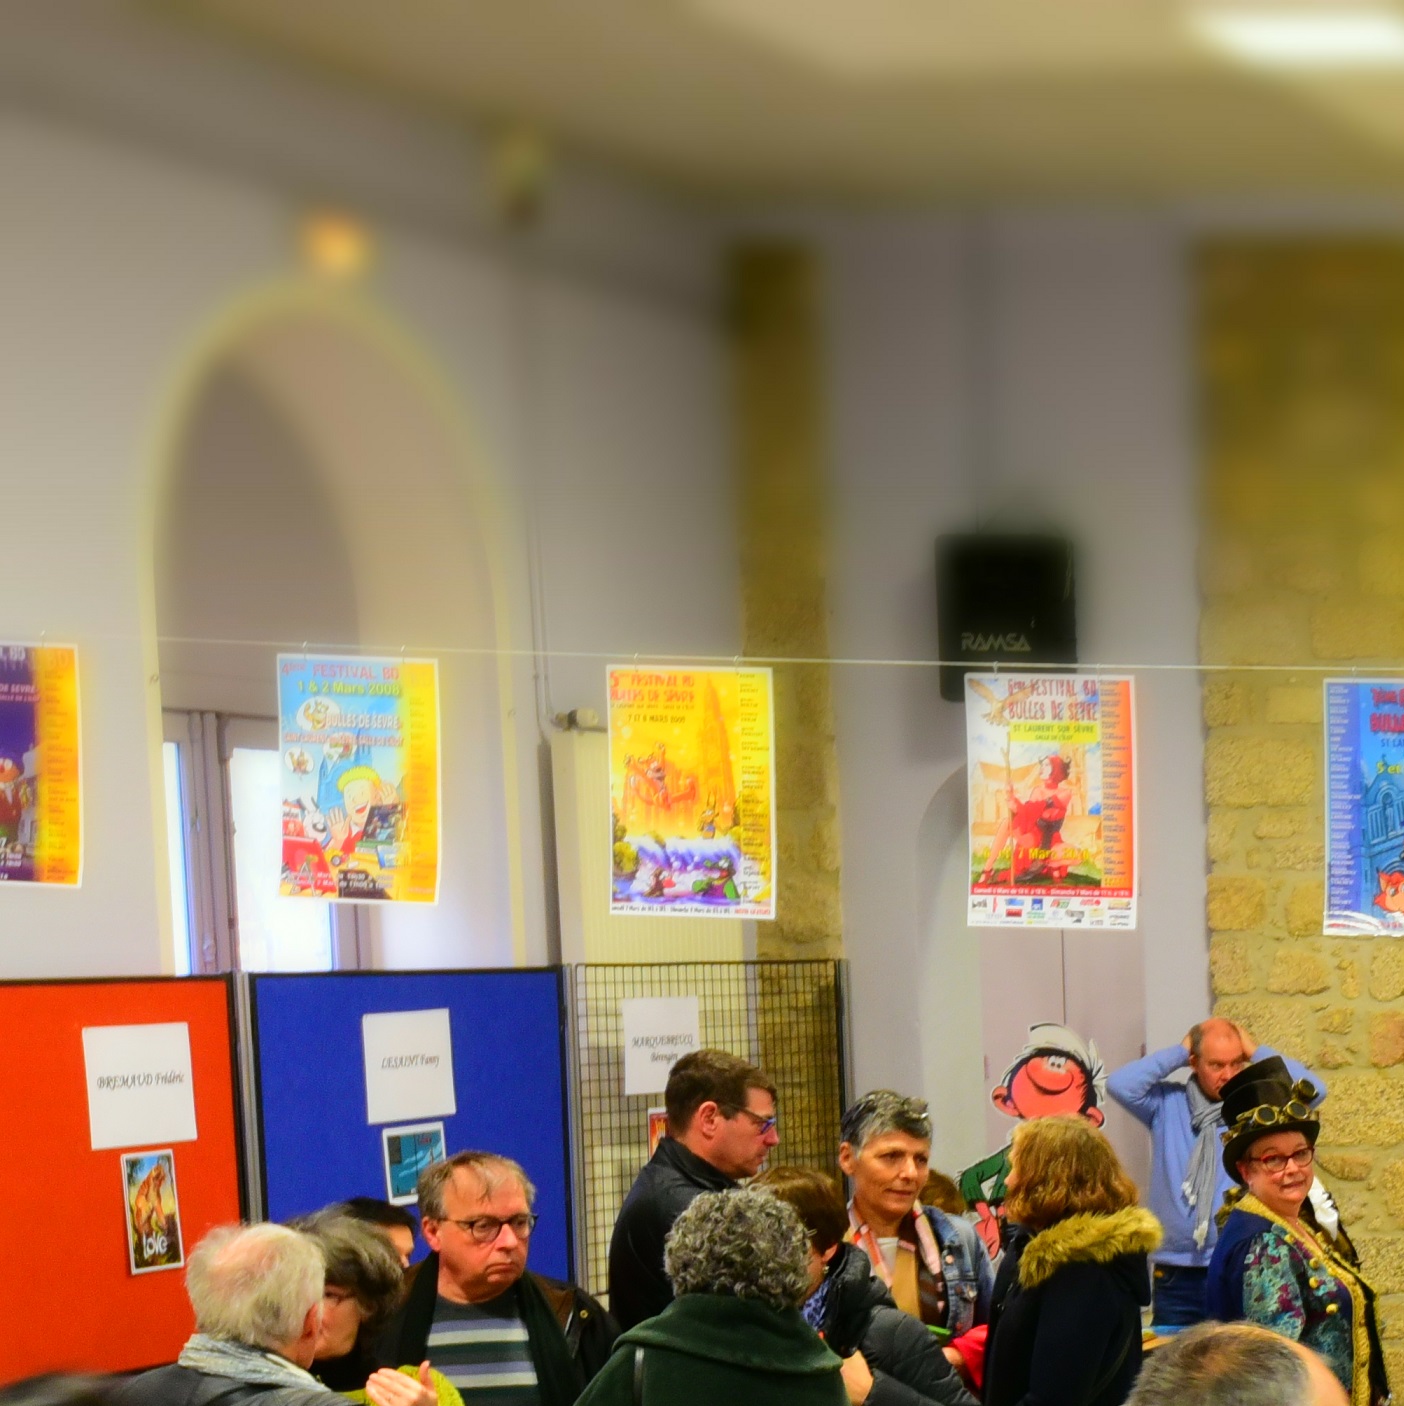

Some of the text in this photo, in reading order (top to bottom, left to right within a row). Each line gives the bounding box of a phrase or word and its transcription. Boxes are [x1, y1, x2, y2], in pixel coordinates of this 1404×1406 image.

[961, 632, 1031, 652] RAMSA
[313, 663, 377, 680] FESTIVAL
[382, 667, 400, 680] BD
[322, 682, 330, 693] 2
[333, 682, 365, 695] Mars
[368, 683, 402, 695] 2008
[1031, 677, 1078, 698] FESTIVAL
[1082, 679, 1098, 697] BD
[1008, 701, 1047, 720] BULLES
[1051, 701, 1064, 721] DE
[1024, 723, 1054, 734] LAURENT
[1057, 724, 1071, 734] SUR
[1376, 762, 1384, 775] 5
[1387, 763, 1401, 775] et
[381, 1052, 440, 1070] LESAINT Fanny
[651, 1051, 678, 1065] Bérengèr
[96, 1070, 185, 1091] BREMAUD Frédéric
